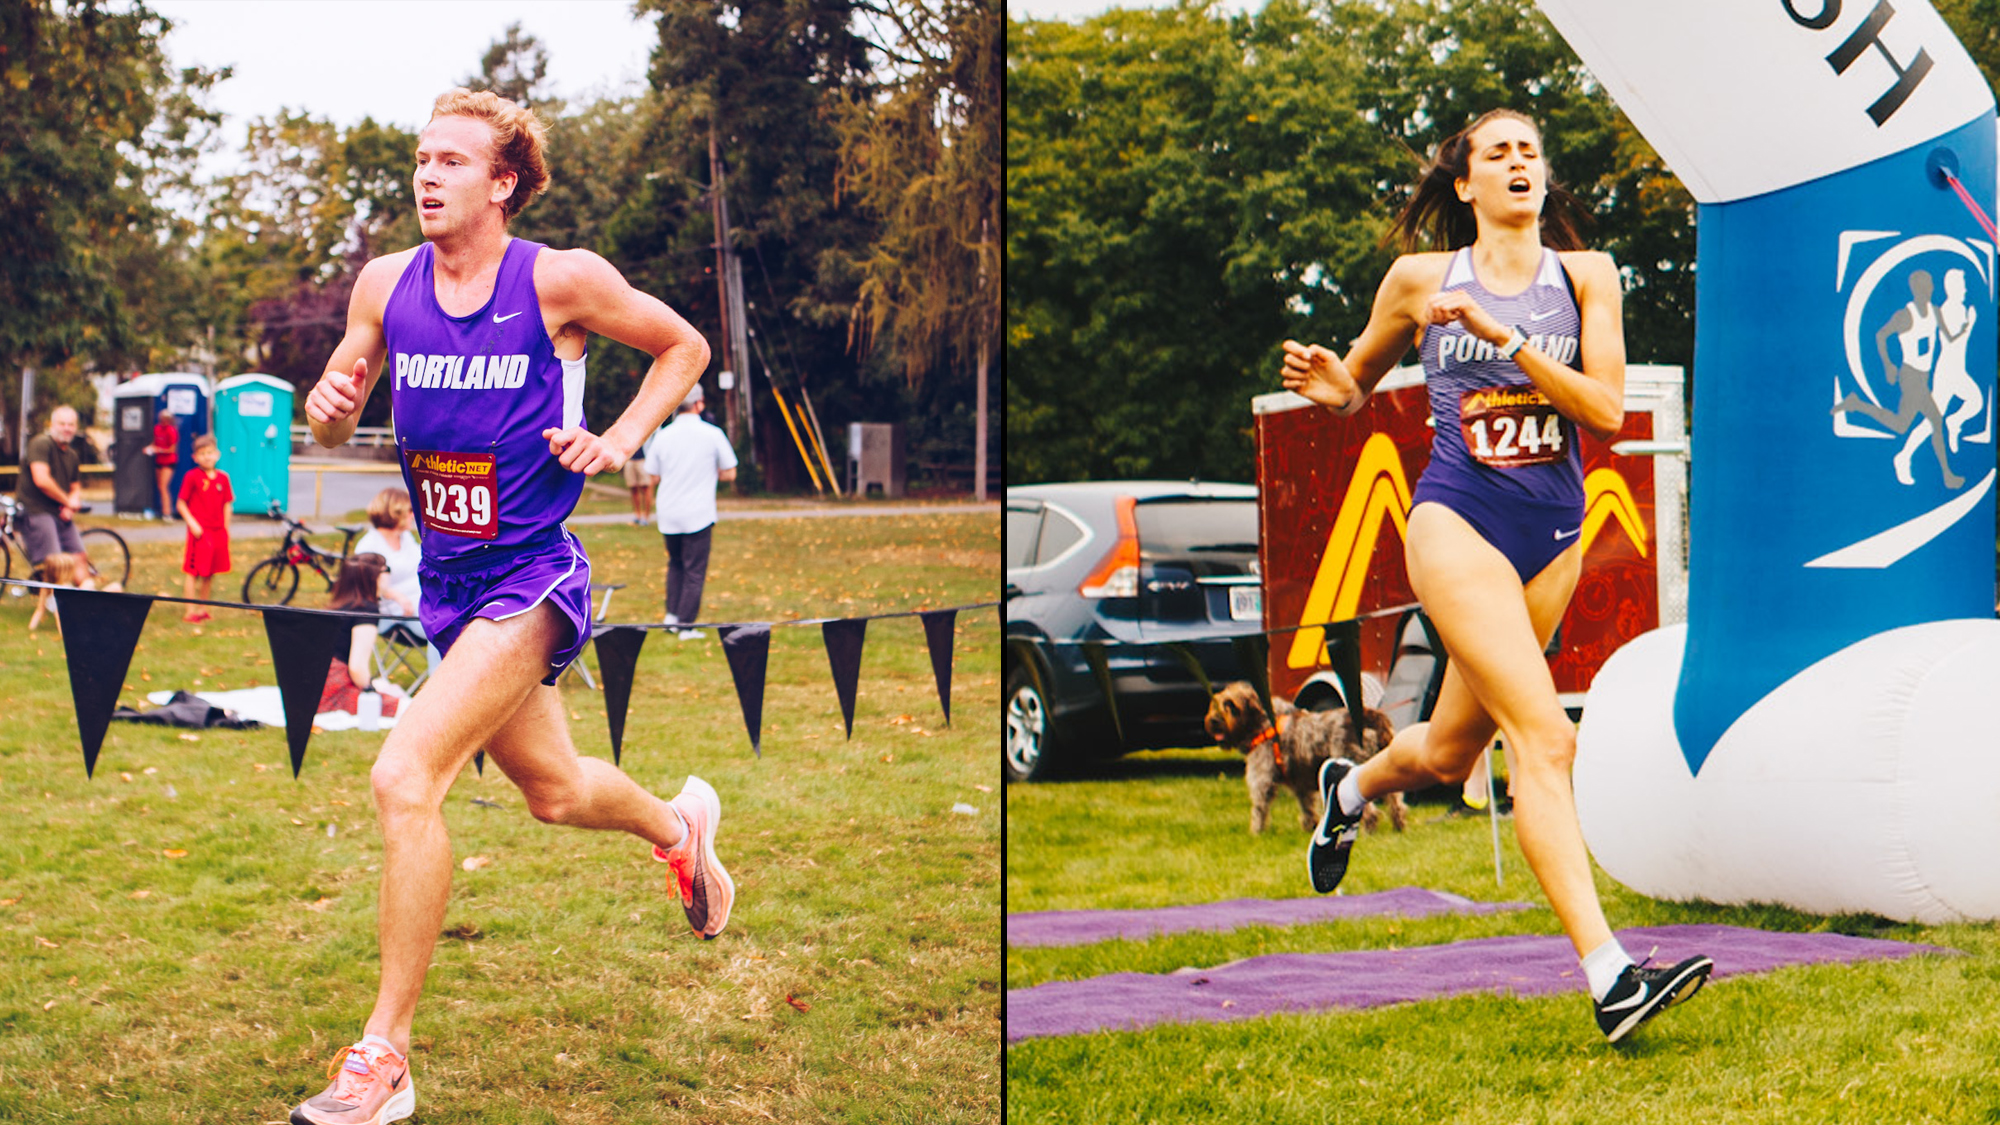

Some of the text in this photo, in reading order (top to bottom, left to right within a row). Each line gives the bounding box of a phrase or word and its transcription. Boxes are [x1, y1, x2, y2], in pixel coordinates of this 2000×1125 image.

[396, 353, 530, 391] PORTLAND
[1470, 413, 1563, 458] 1244
[421, 479, 491, 526] 1239
